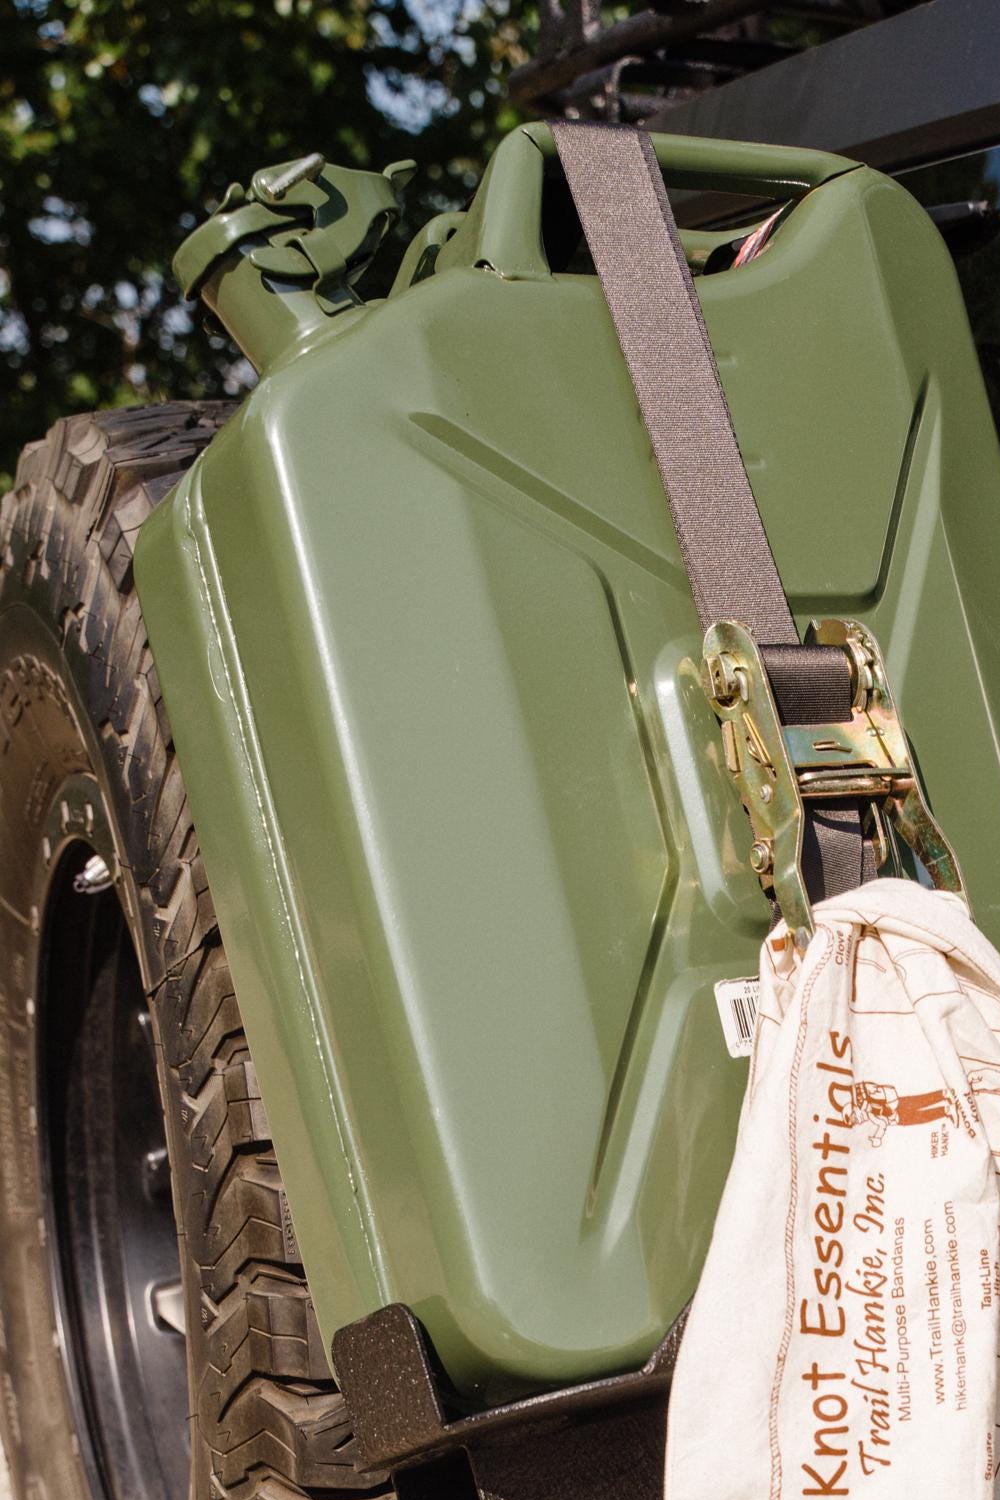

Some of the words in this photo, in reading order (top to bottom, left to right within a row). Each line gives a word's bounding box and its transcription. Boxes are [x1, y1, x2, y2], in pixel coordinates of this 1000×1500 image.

[835, 929, 845, 966] Clove
[800, 1030, 853, 1337] Essentials
[931, 1131, 939, 1159] HIKER
[853, 1172, 885, 1234] Inc.
[891, 1217, 905, 1299] Bandanas
[980, 1249, 992, 1310] Taut-Line
[845, 1248, 889, 1376] Hankie,
[943, 1200, 967, 1412] hikerhank@trailhankie.com
[895, 1304, 912, 1422] Multi-Purpose
[801, 1361, 849, 1496] Knot
[851, 1378, 891, 1476] Trail
[984, 1432, 993, 1481] Square
